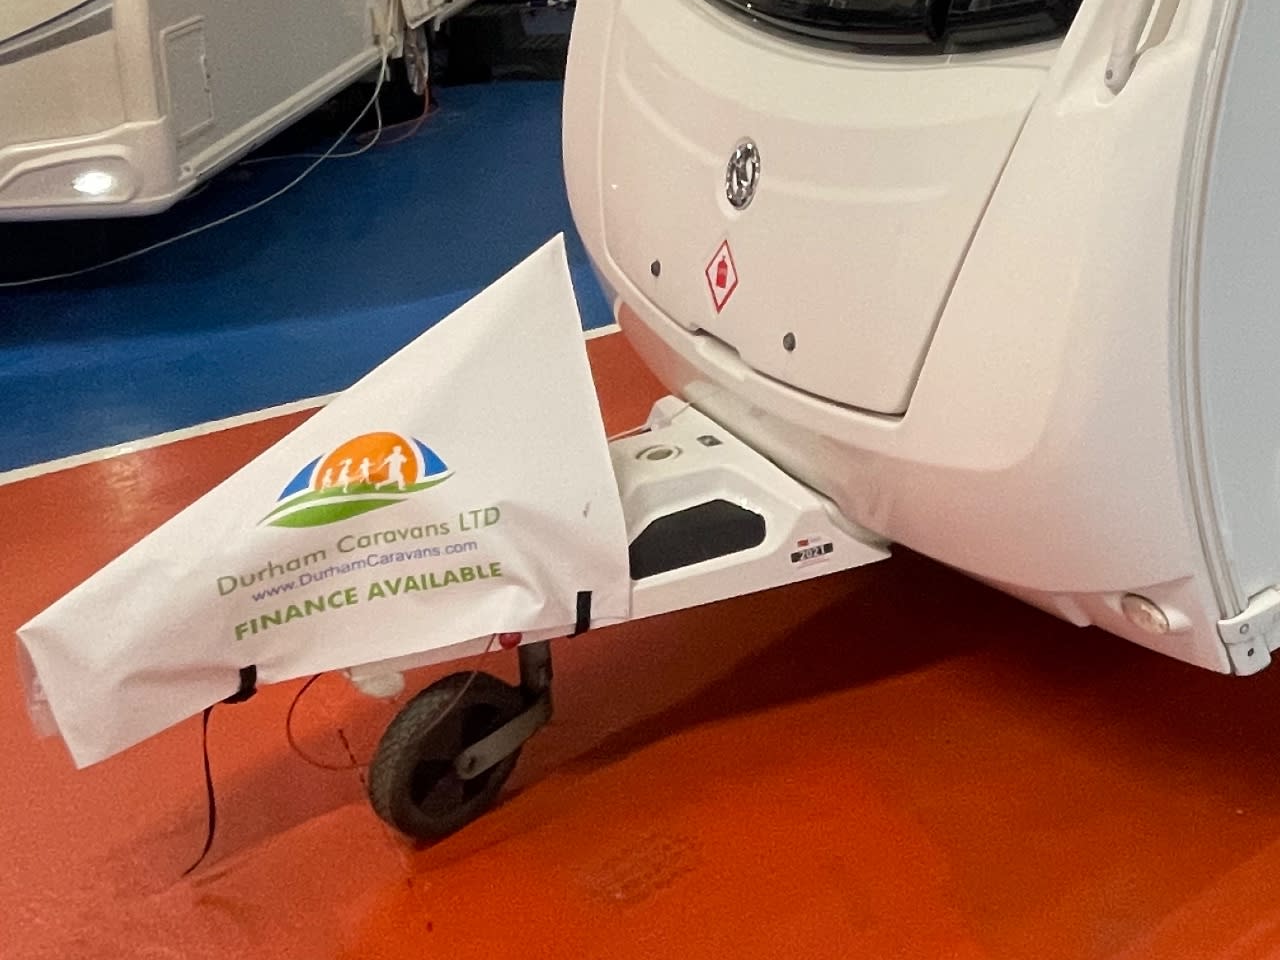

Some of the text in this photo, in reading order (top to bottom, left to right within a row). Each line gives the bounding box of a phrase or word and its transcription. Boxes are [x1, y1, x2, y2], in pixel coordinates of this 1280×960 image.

[216, 505, 501, 597] Durham Caravans LTD
[251, 539, 479, 603] www.DurhamCaravans.com
[233, 561, 503, 641] FINANCE AVAILABLE
